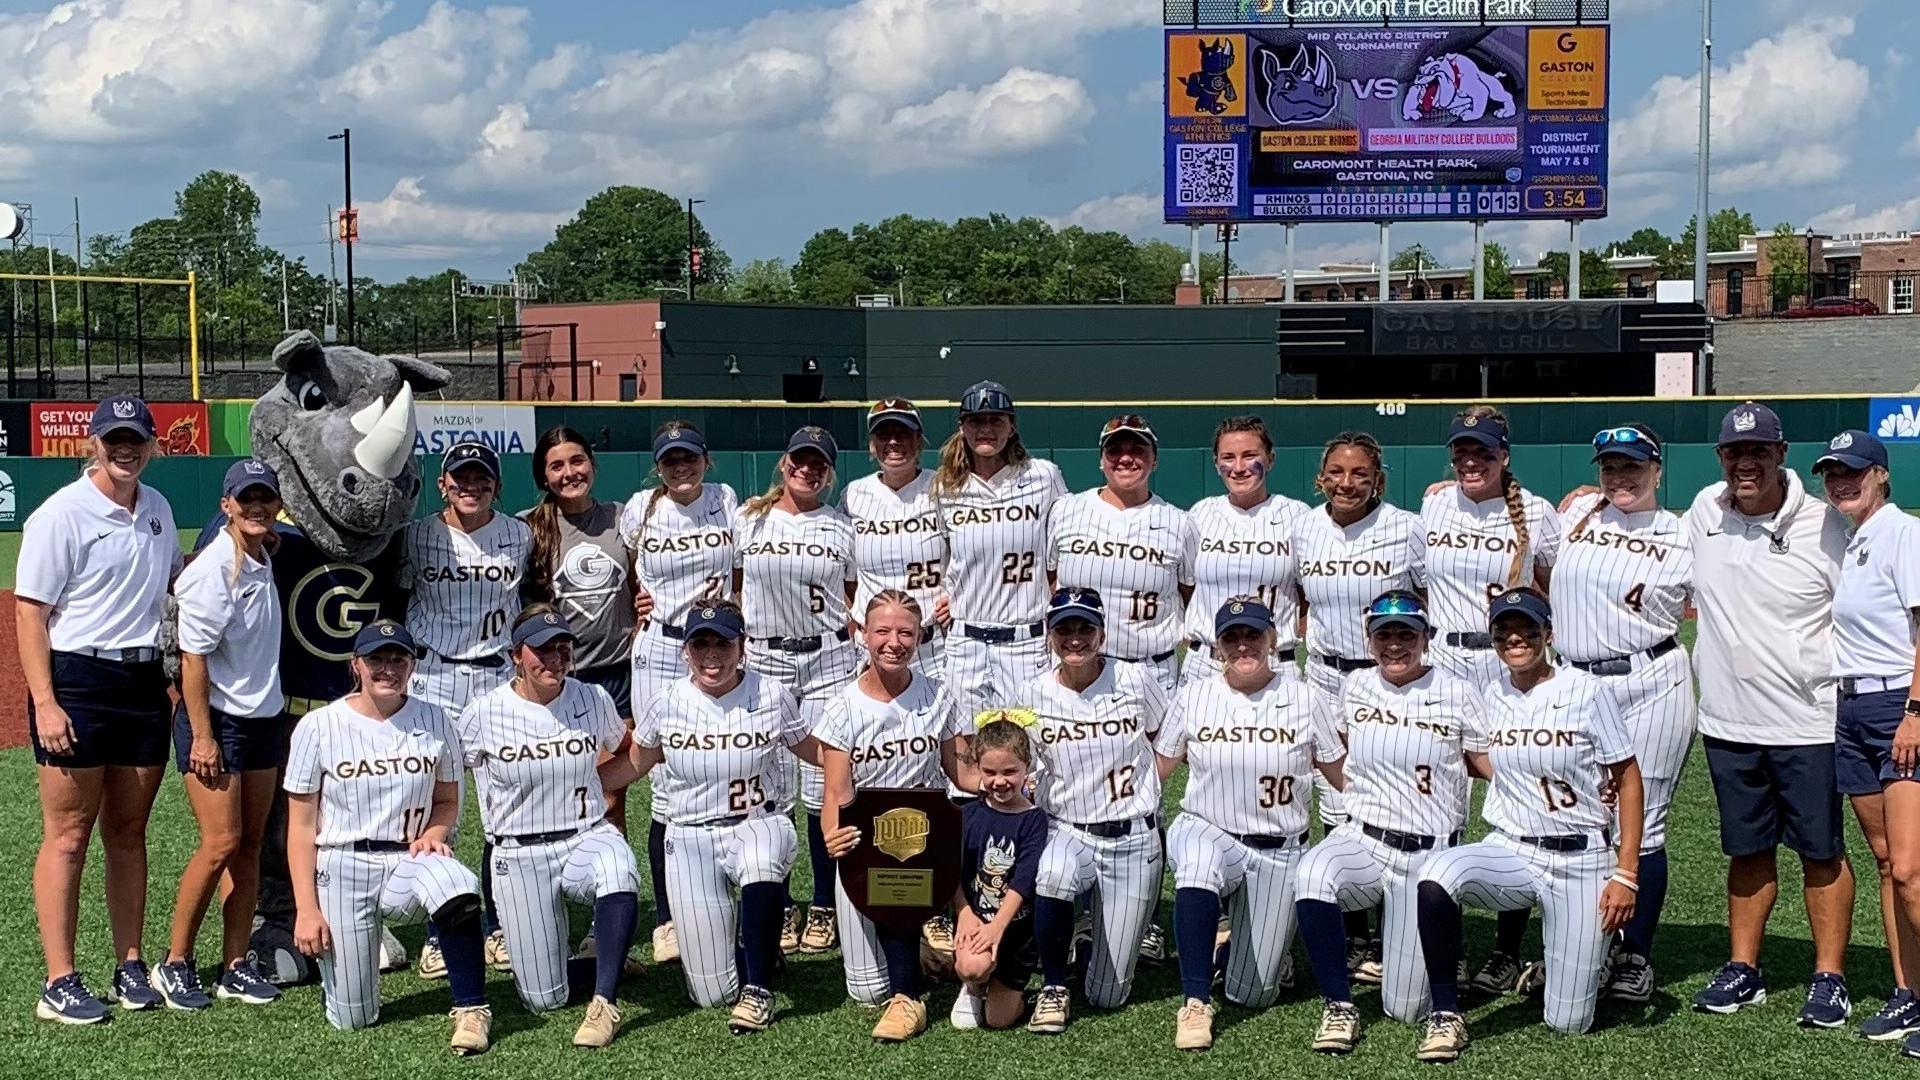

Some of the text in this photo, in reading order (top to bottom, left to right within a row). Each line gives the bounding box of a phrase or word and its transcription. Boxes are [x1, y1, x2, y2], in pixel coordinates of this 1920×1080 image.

[1282, 0, 1535, 17] CaroMont Health Park
[1307, 31, 1449, 41] MID ATLANTIC DISTRICT
[1336, 42, 1421, 51] TOURNAMENT
[1557, 32, 1577, 53] G
[1540, 61, 1594, 73] GASTON
[1350, 79, 1399, 100] VS
[1262, 134, 1357, 147] GASTON COLLEGE RHINOS
[1370, 133, 1515, 146] GEORGIA MILITARY COLLEGE BULLDOGS
[1542, 132, 1589, 142] DISTRICT
[1530, 144, 1600, 155] TOURNAMENT
[1293, 158, 1477, 170] CAROMONT HEALTH PARK,
[1540, 156, 1589, 166] MAY 7 & 8
[1336, 171, 1434, 182] GASTONIA, NC
[1265, 194, 1311, 204] RHINOS
[1479, 195, 1489, 210] 0
[1494, 195, 1503, 210] 1
[1507, 195, 1518, 210] 3
[1544, 190, 1586, 207] 3:54
[1262, 205, 1312, 215] BULLDOGS
[1383, 310, 1602, 332] GAS HOUSE
[1406, 333, 1577, 350] BAR & GRILL
[40, 411, 64, 423] GET
[1375, 403, 1406, 416] 400
[40, 424, 80, 436] WHILE
[433, 416, 484, 426] MAZDA OF
[414, 430, 525, 454] ASTONIA
[952, 504, 1040, 526] GASTON
[856, 516, 938, 536] GASTON
[644, 528, 734, 554] GASTON
[747, 541, 840, 560] GASTON
[1071, 538, 1165, 565] GASTON
[1200, 537, 1290, 557] GASTON
[1568, 529, 1668, 563] GASTON
[423, 565, 517, 583] GASTON
[564, 541, 614, 590] G
[906, 558, 941, 591] 25
[1003, 550, 1035, 585] 22
[1300, 559, 1392, 577] GASTON
[808, 584, 824, 615] 5
[1130, 590, 1159, 622] 18
[1624, 582, 1646, 613] 4
[289, 562, 380, 662] G
[481, 608, 506, 641] 10
[669, 731, 772, 751] GASTON
[1040, 717, 1138, 745] GASTON
[1199, 726, 1296, 744] GASTON
[500, 735, 598, 763] GASTON
[850, 732, 941, 764] GASTON
[336, 755, 438, 779] GASTON
[1107, 765, 1136, 802] 12
[1415, 764, 1432, 796] 3
[574, 785, 588, 820] 7
[728, 774, 767, 812] 23
[1258, 775, 1295, 809] 30
[1539, 776, 1578, 812] 13
[403, 806, 426, 843] 17
